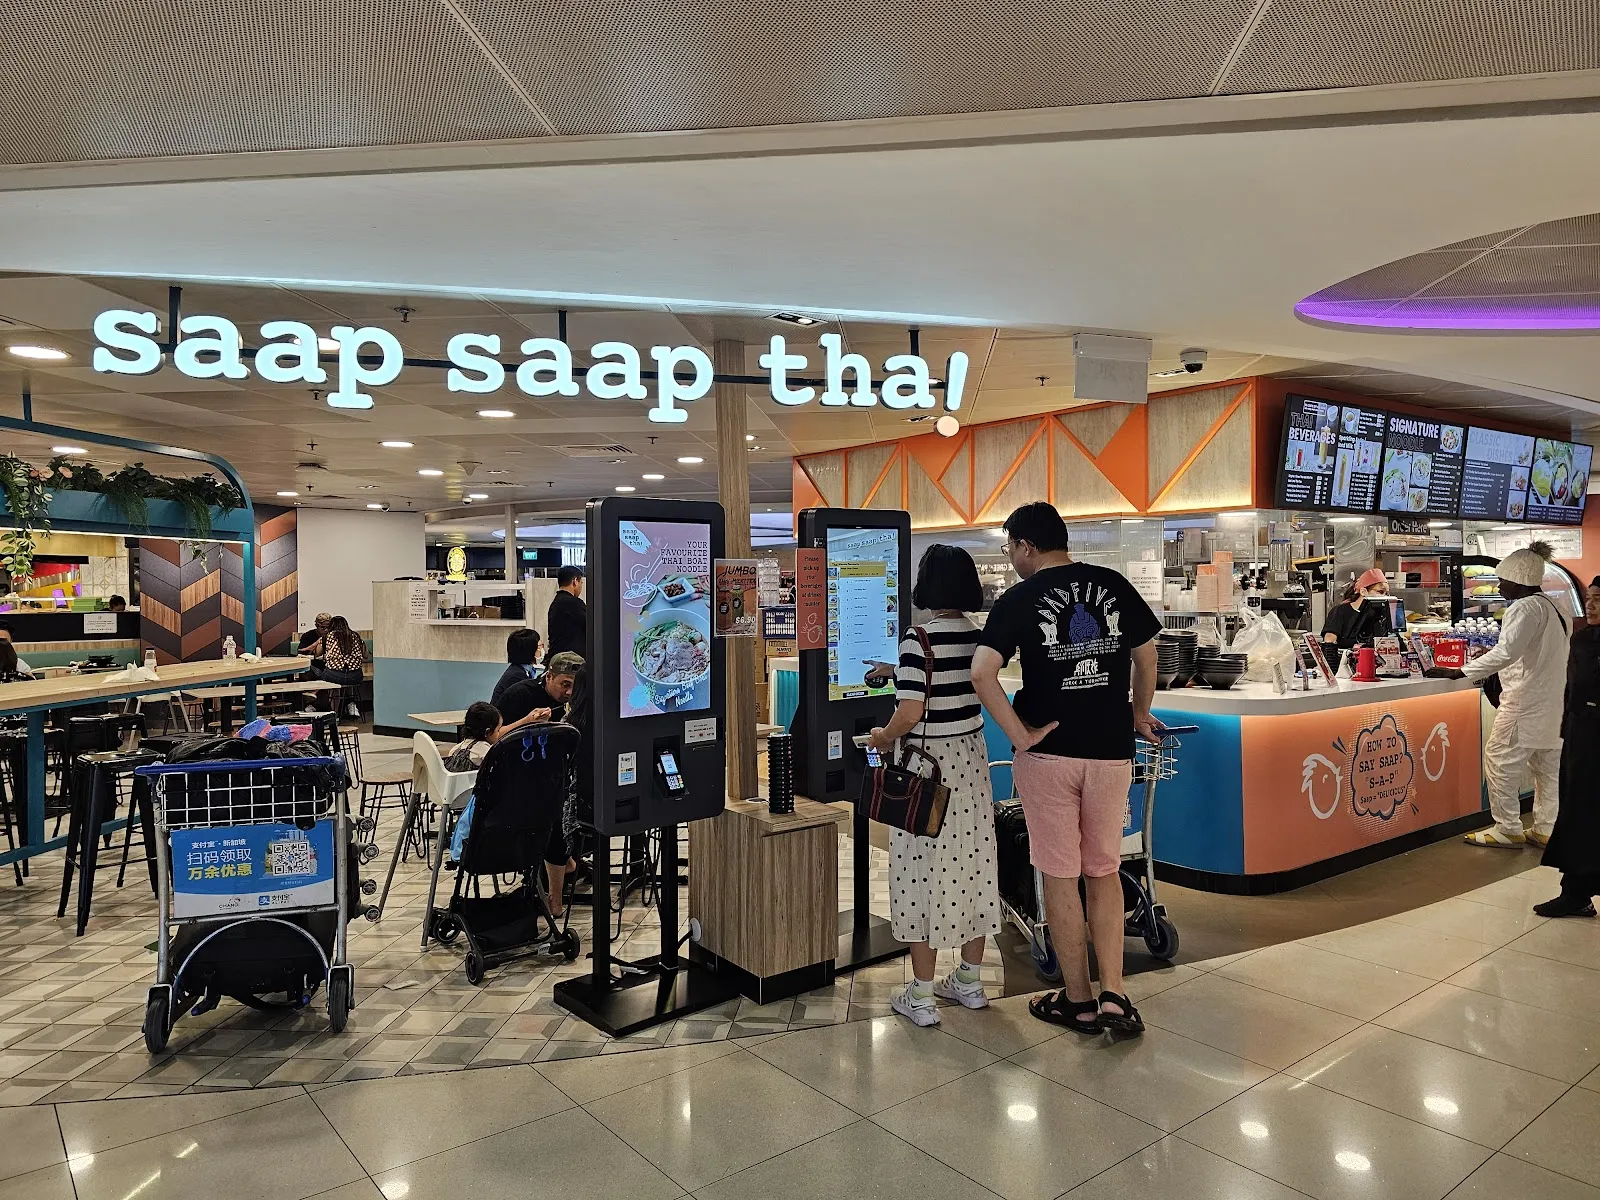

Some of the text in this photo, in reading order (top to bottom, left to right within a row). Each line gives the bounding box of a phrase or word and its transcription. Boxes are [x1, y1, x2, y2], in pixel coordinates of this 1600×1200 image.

[93, 309, 404, 409] saap
[447, 333, 714, 423] saap
[1289, 427, 1336, 445] BEVERAGES
[1389, 417, 1440, 439] SIGNATURE
[1387, 432, 1425, 452] NOODLE
[660, 549, 708, 557] FAVOURITE
[687, 541, 708, 549] YOUR
[723, 565, 757, 577] JUMBO
[1367, 736, 1397, 753] HOW TO
[1359, 752, 1404, 773] SAY SAAP?
[186, 848, 252, 866] 扫码领取
